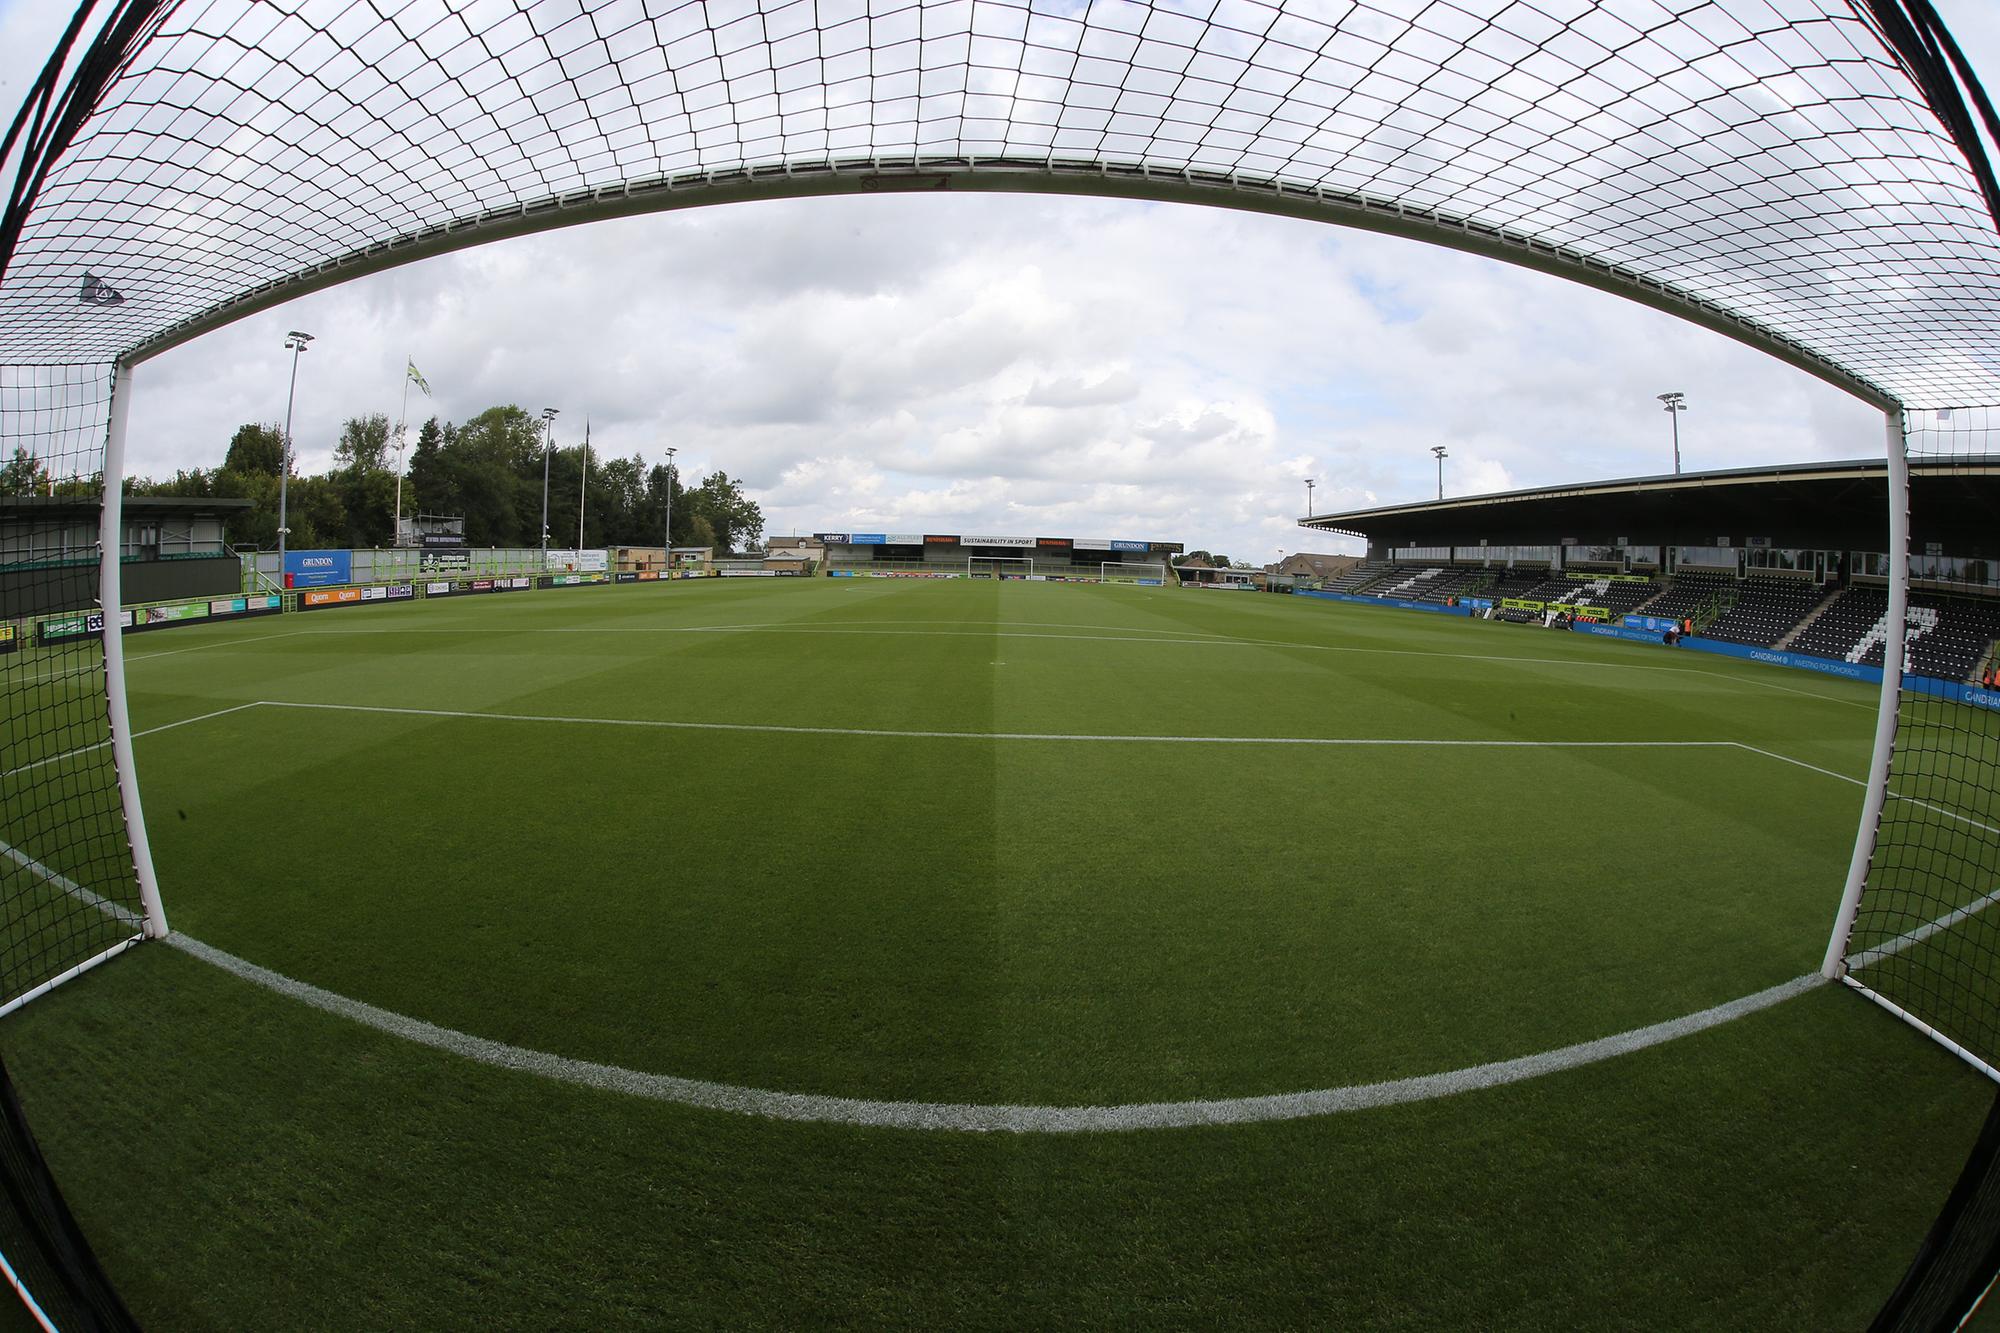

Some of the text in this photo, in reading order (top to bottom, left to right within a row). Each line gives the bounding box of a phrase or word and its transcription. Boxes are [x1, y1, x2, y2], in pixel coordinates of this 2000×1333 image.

[302, 557, 333, 567] GRUNDON
[311, 594, 329, 603] Quorn
[339, 592, 356, 600] Quorn
[1750, 651, 1782, 663] CANDRIAM
[1794, 659, 1819, 669] INVESTING
